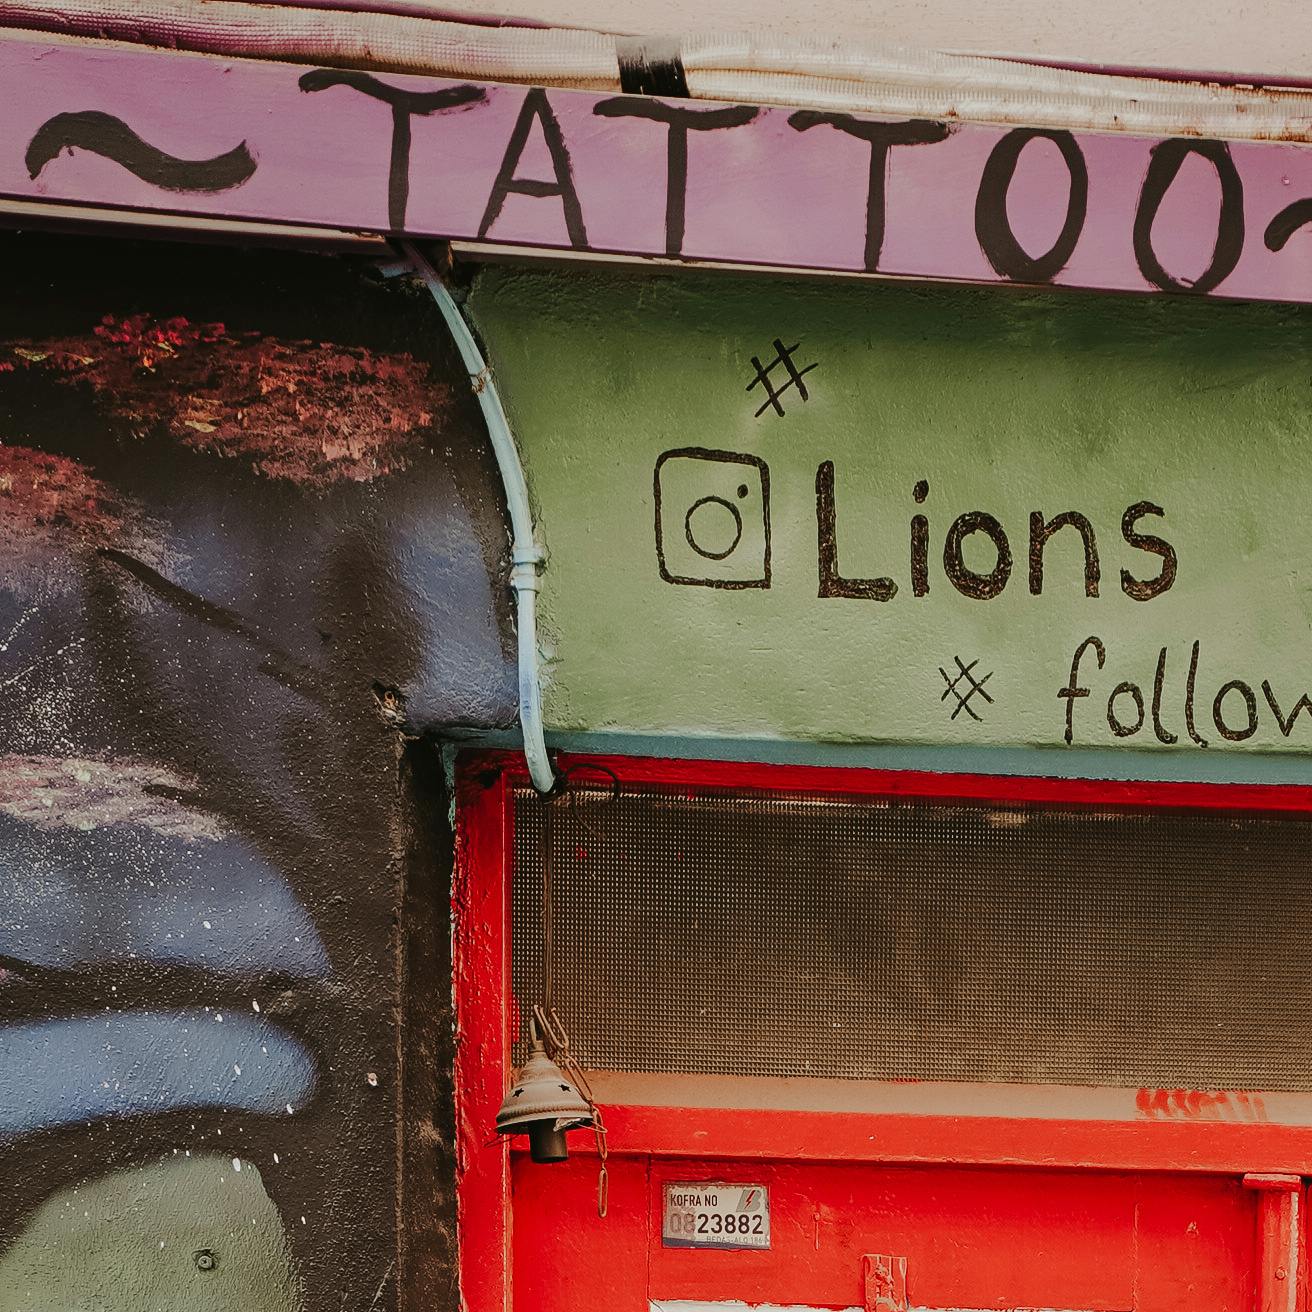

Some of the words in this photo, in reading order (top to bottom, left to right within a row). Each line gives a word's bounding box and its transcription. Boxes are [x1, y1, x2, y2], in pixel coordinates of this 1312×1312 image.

[814, 459, 1178, 602] Lions
[670, 1194, 702, 1207] KOFRA
[704, 1194, 718, 1207] NO
